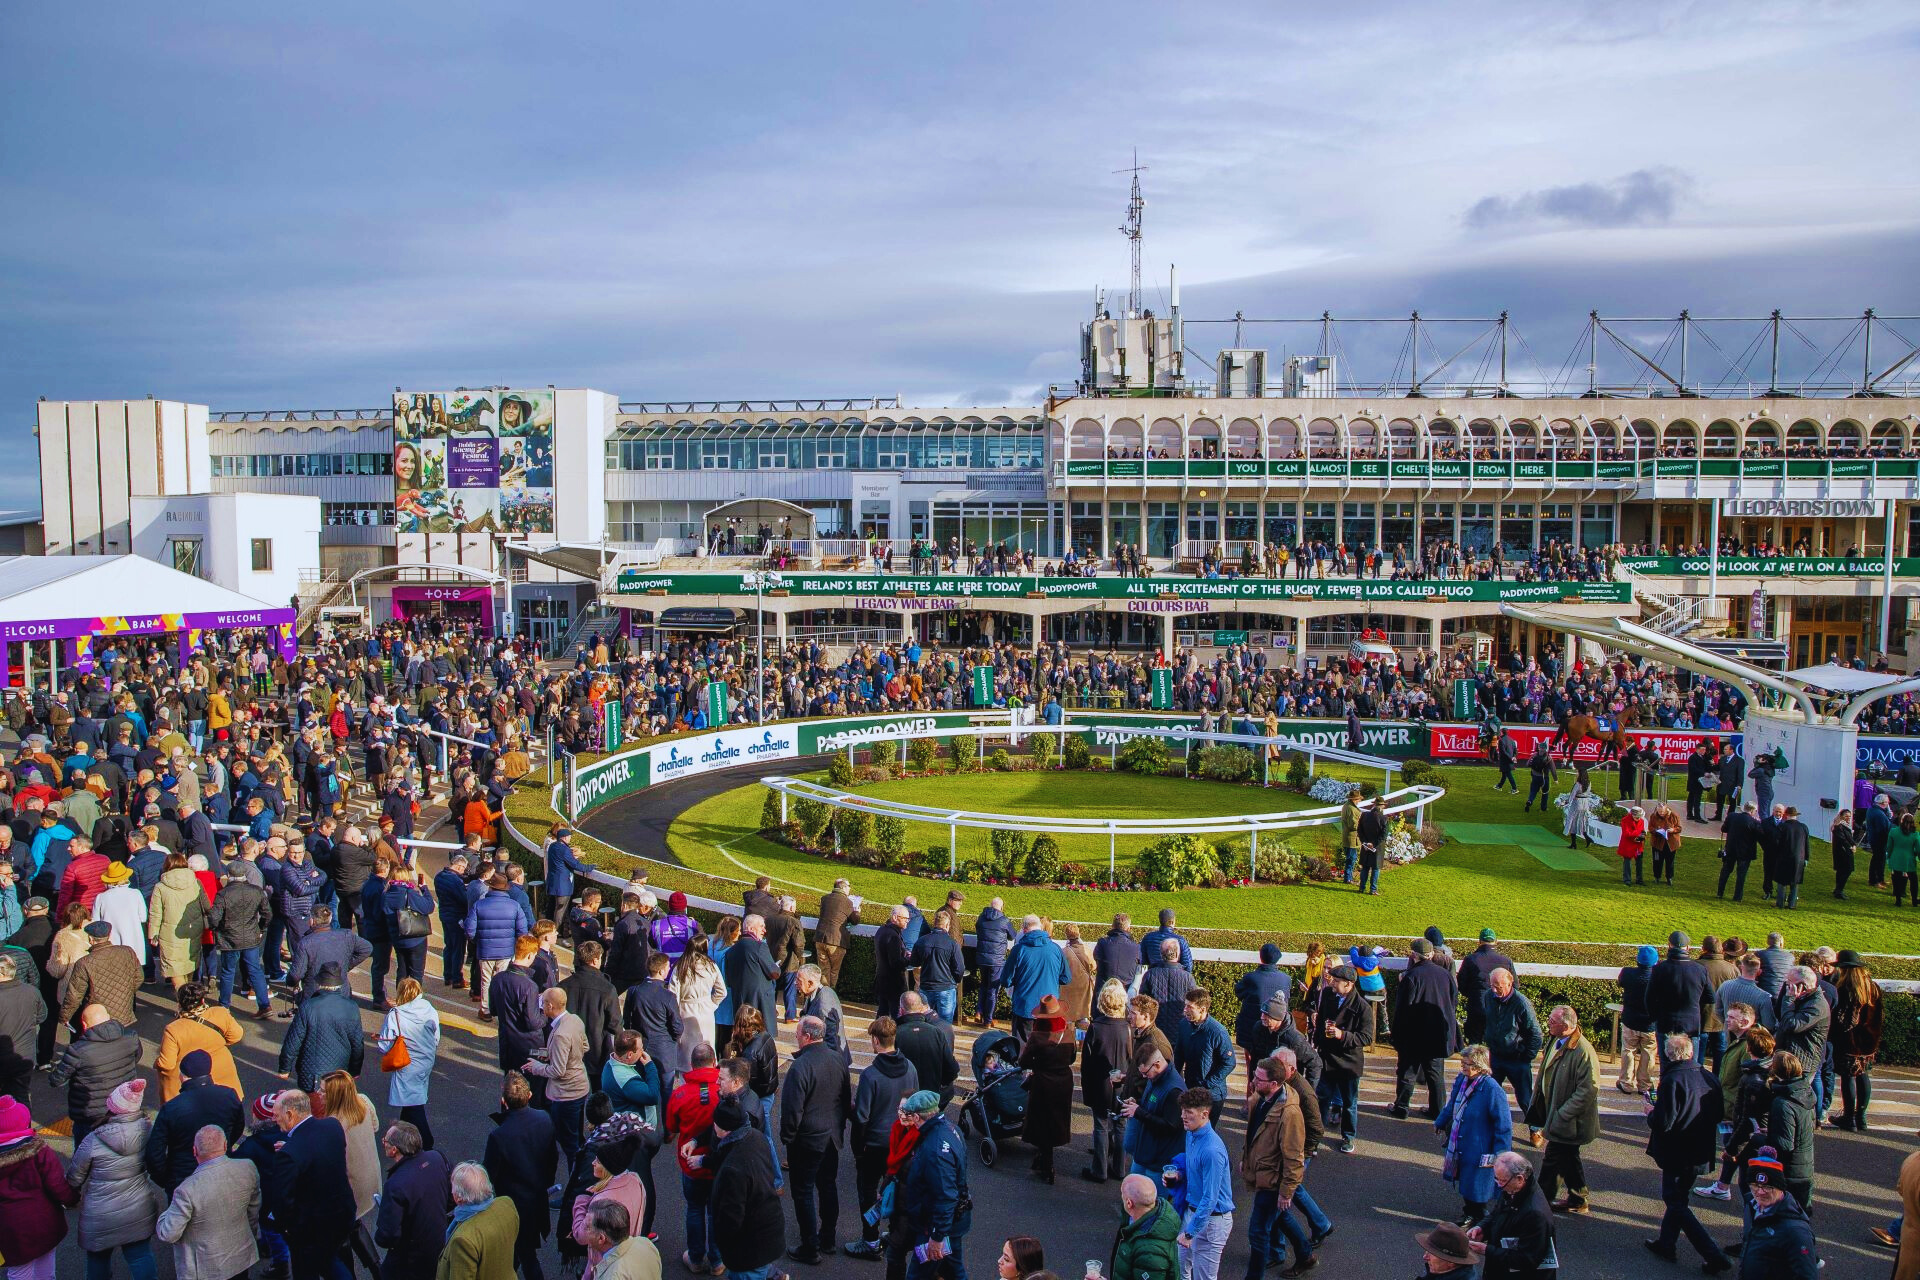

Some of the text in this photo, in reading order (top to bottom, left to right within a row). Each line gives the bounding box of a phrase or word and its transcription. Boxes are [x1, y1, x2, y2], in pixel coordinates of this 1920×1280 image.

[1236, 463, 1546, 474] YOU CAN ALMOST SEE CHELTENHAM FROM HERE.
[1732, 500, 1875, 516] LEOPARDSTOWN
[1623, 560, 1659, 570] YPOWER
[1682, 561, 1901, 572] OOOH LOOK AT ME I'M ON A BALCOY
[802, 580, 1022, 592] IRELAND'S BEST ATHLETES ARE HERE TODAY
[1126, 583, 1473, 596] ALL THE EXCITEMENT OF THE RUGBY, FEWER LADS CALLED HUGO
[425, 589, 461, 599] tote
[855, 598, 954, 610] LEGACY WINE BAR
[1127, 600, 1209, 612] COLOURS BAR
[218, 614, 262, 623] WELCOME
[5, 624, 55, 636] ELCOME
[132, 620, 152, 629] BAR
[748, 739, 790, 755] chanelle
[701, 747, 740, 763] chanelle
[756, 752, 781, 761] PHARMA
[657, 755, 693, 773] chanelle
[708, 759, 731, 769] PHARMA
[664, 769, 685, 779] PHARMA
